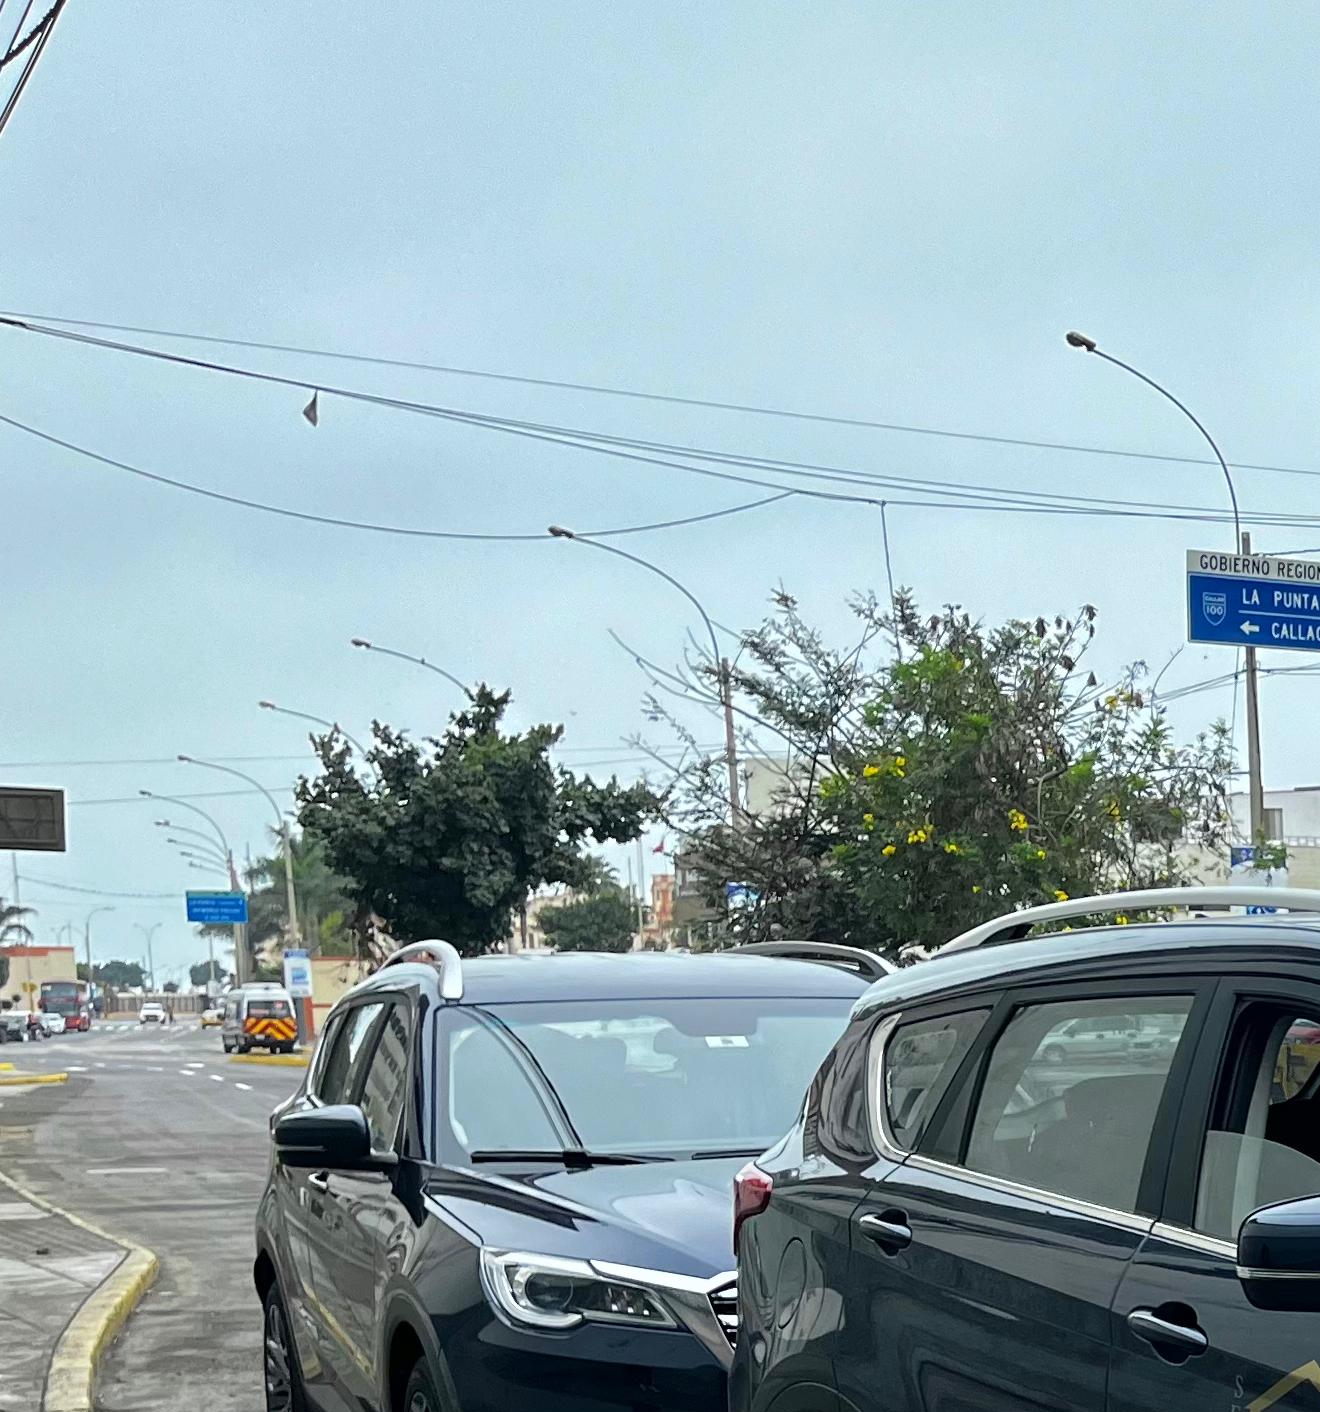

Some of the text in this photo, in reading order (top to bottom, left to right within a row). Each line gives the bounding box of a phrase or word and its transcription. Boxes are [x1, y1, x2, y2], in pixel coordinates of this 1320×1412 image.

[1200, 554, 1270, 576] GOBIERNO
[1206, 605, 1224, 616] 100
[1242, 588, 1260, 606] LA
[1274, 590, 1320, 611] PUNTA
